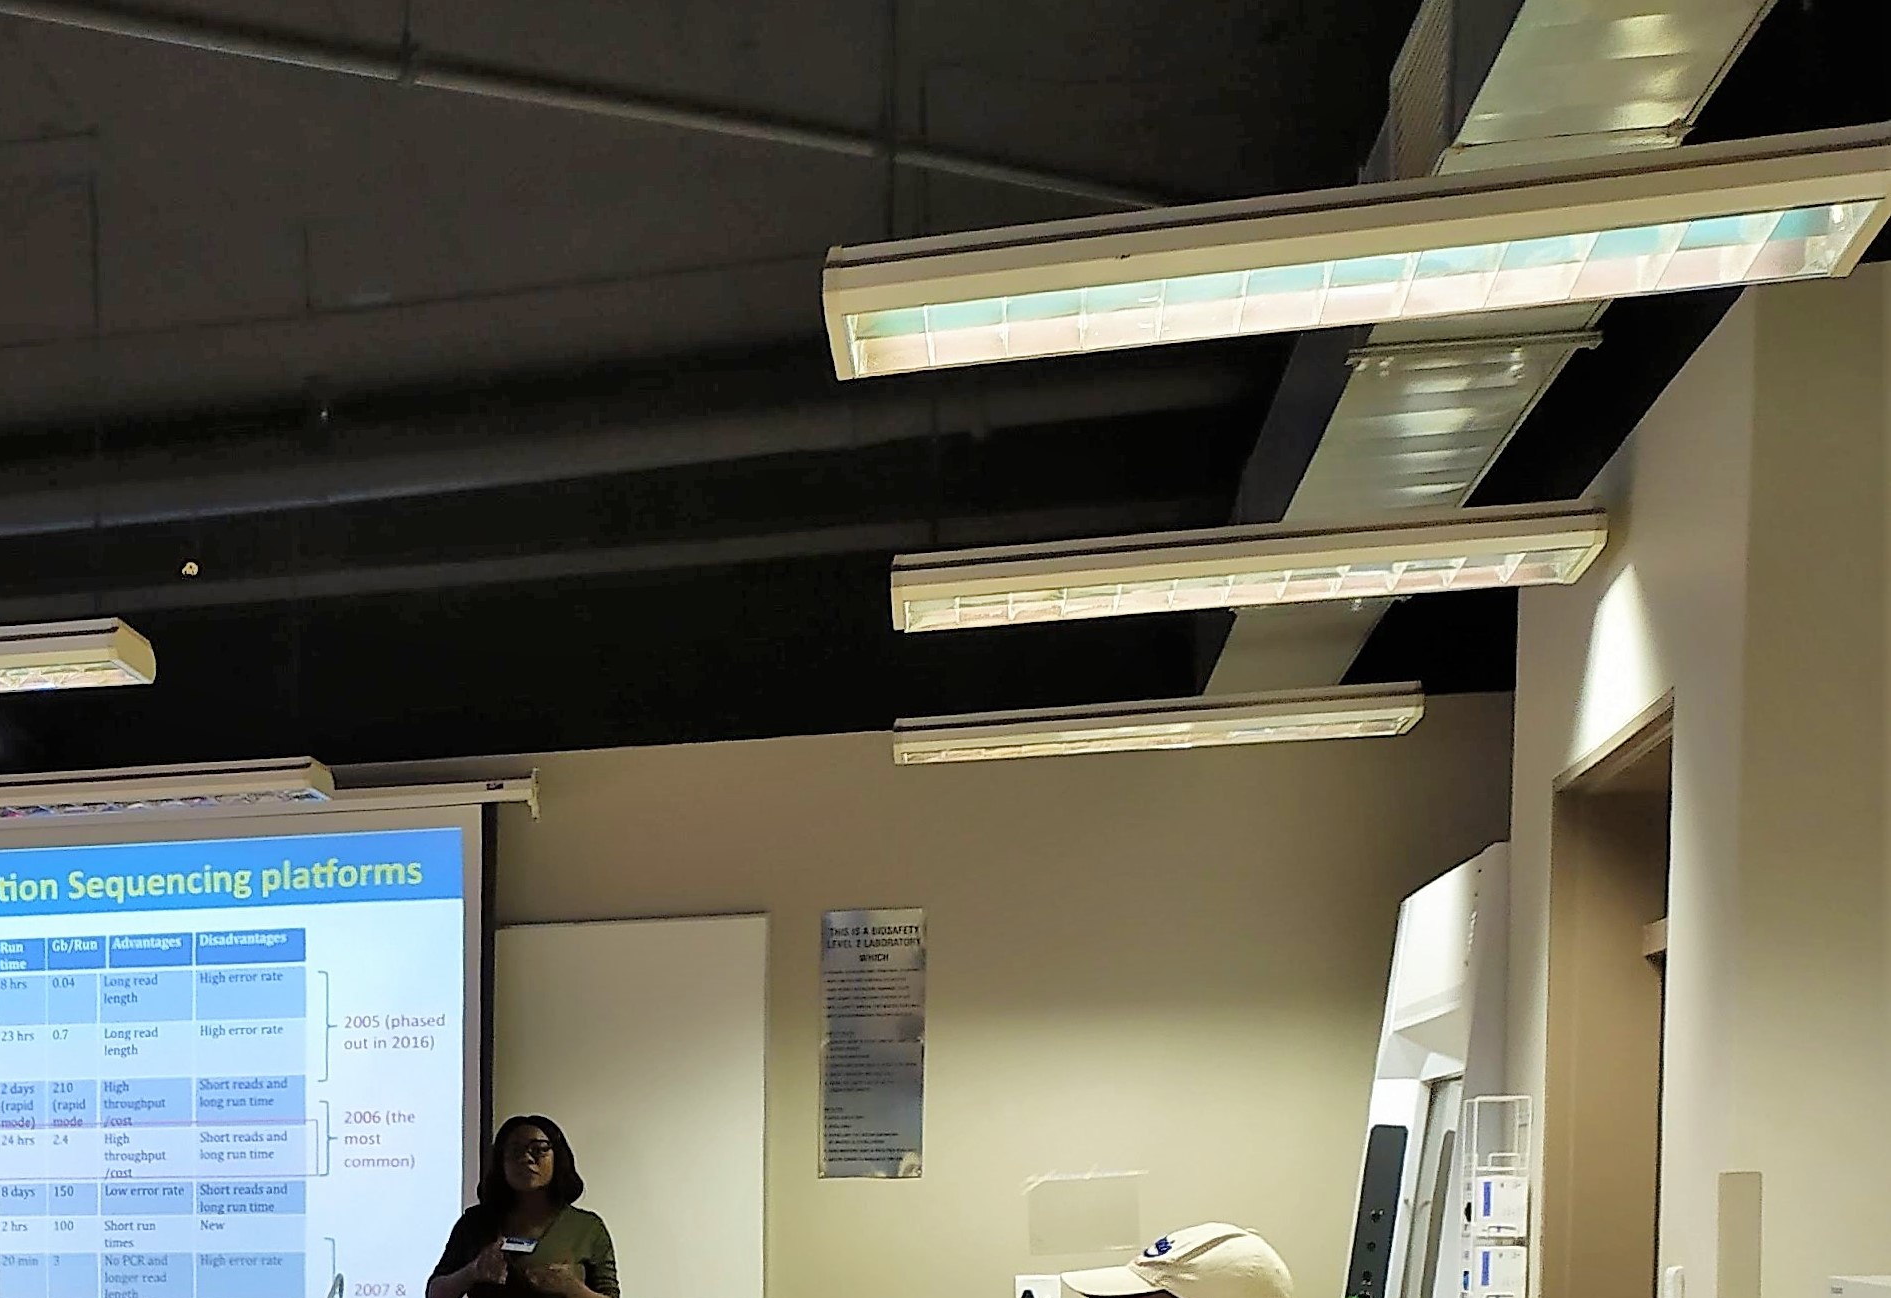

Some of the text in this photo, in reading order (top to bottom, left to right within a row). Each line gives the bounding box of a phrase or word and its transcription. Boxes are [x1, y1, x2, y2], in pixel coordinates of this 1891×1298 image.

[67, 864, 252, 907] Sequencing
[261, 858, 424, 898] platforms
[828, 925, 919, 937] THIS IS A BIOSAFETY
[52, 939, 98, 953] Gb/Run
[112, 936, 182, 951] Advantages
[199, 932, 287, 948] Disadvantages
[827, 939, 852, 949] LEVEL
[864, 937, 921, 948] LABORATORY
[0, 942, 23, 953] Run
[0, 959, 27, 970] time
[859, 953, 889, 962] WHICH
[52, 977, 75, 988] 0.04
[104, 973, 158, 989] Long read
[199, 971, 284, 986] High error rate
[104, 991, 138, 1006] length
[344, 1013, 446, 1030] 2005 (phased
[1, 1030, 34, 1042] 23 hrs
[52, 1030, 69, 1041] 0.7
[104, 1027, 158, 1042] Long read
[200, 1024, 284, 1039] High error rate
[344, 1035, 435, 1051] out in 2016)
[104, 1044, 138, 1059] length
[53, 1082, 74, 1094] 210
[104, 1081, 130, 1095] High
[199, 1077, 288, 1091] Short reads and
[1, 1099, 34, 1114] (rapid
[52, 1098, 86, 1113] (rapid
[104, 1097, 166, 1112] throughput
[199, 1095, 274, 1109] long run time
[1, 1116, 36, 1130] mode)
[104, 1115, 134, 1128] /cost
[344, 1110, 416, 1125] 2006 (the
[1, 1134, 35, 1146] 24 hrs
[53, 1134, 69, 1145] 2.4
[104, 1132, 130, 1146] High
[200, 1130, 288, 1143] Short reads and
[344, 1134, 381, 1145] most
[104, 1150, 166, 1164] throughput
[200, 1148, 275, 1162] long run time
[344, 1154, 416, 1169] common)
[1, 1185, 36, 1199] 8 days
[53, 1186, 74, 1197] 150
[105, 1185, 185, 1197] Low error rate
[200, 1183, 288, 1196] Short reads and
[200, 1200, 275, 1215] long run time
[53, 1220, 74, 1231] 100
[104, 1220, 156, 1232] Short run
[200, 1219, 225, 1231] New
[104, 1237, 134, 1248] times
[1, 1256, 38, 1267] 20 min
[104, 1255, 168, 1266] No PCR and
[200, 1255, 284, 1269] High error rate
[104, 1272, 167, 1286] longer read
[354, 1283, 406, 1297] 2007 &
